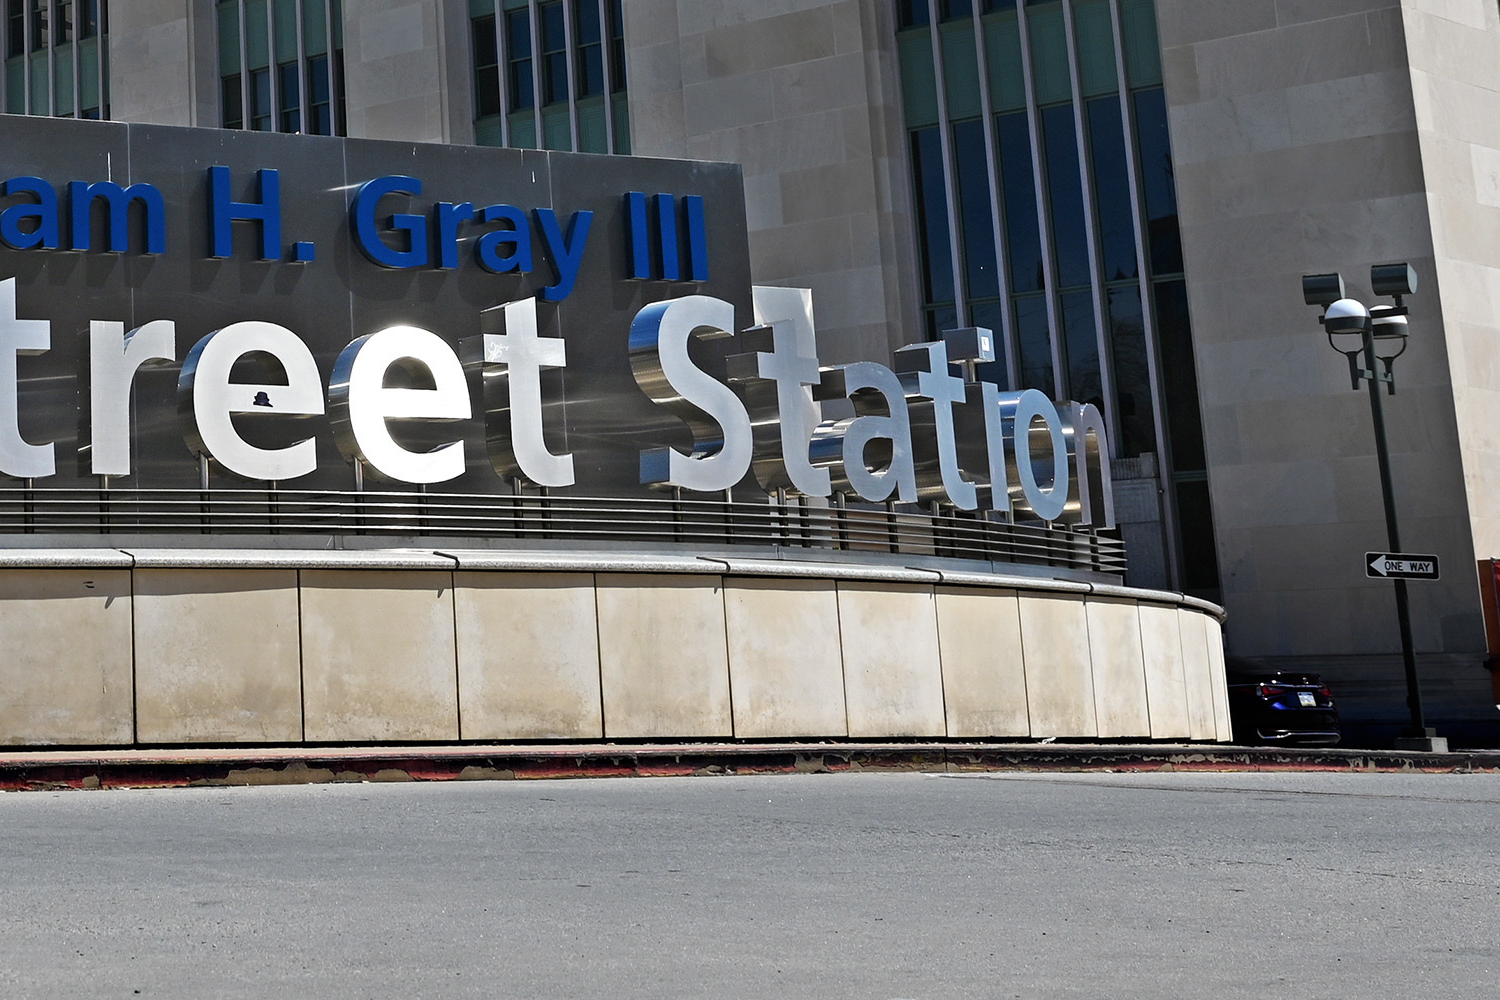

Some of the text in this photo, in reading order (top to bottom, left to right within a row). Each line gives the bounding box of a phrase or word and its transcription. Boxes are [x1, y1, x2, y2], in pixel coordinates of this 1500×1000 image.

[206, 165, 315, 263] H.
[351, 175, 594, 301] Gray
[623, 191, 709, 282] III
[629, 295, 1116, 531] Station
[1384, 560, 1431, 572] ONE WAY
